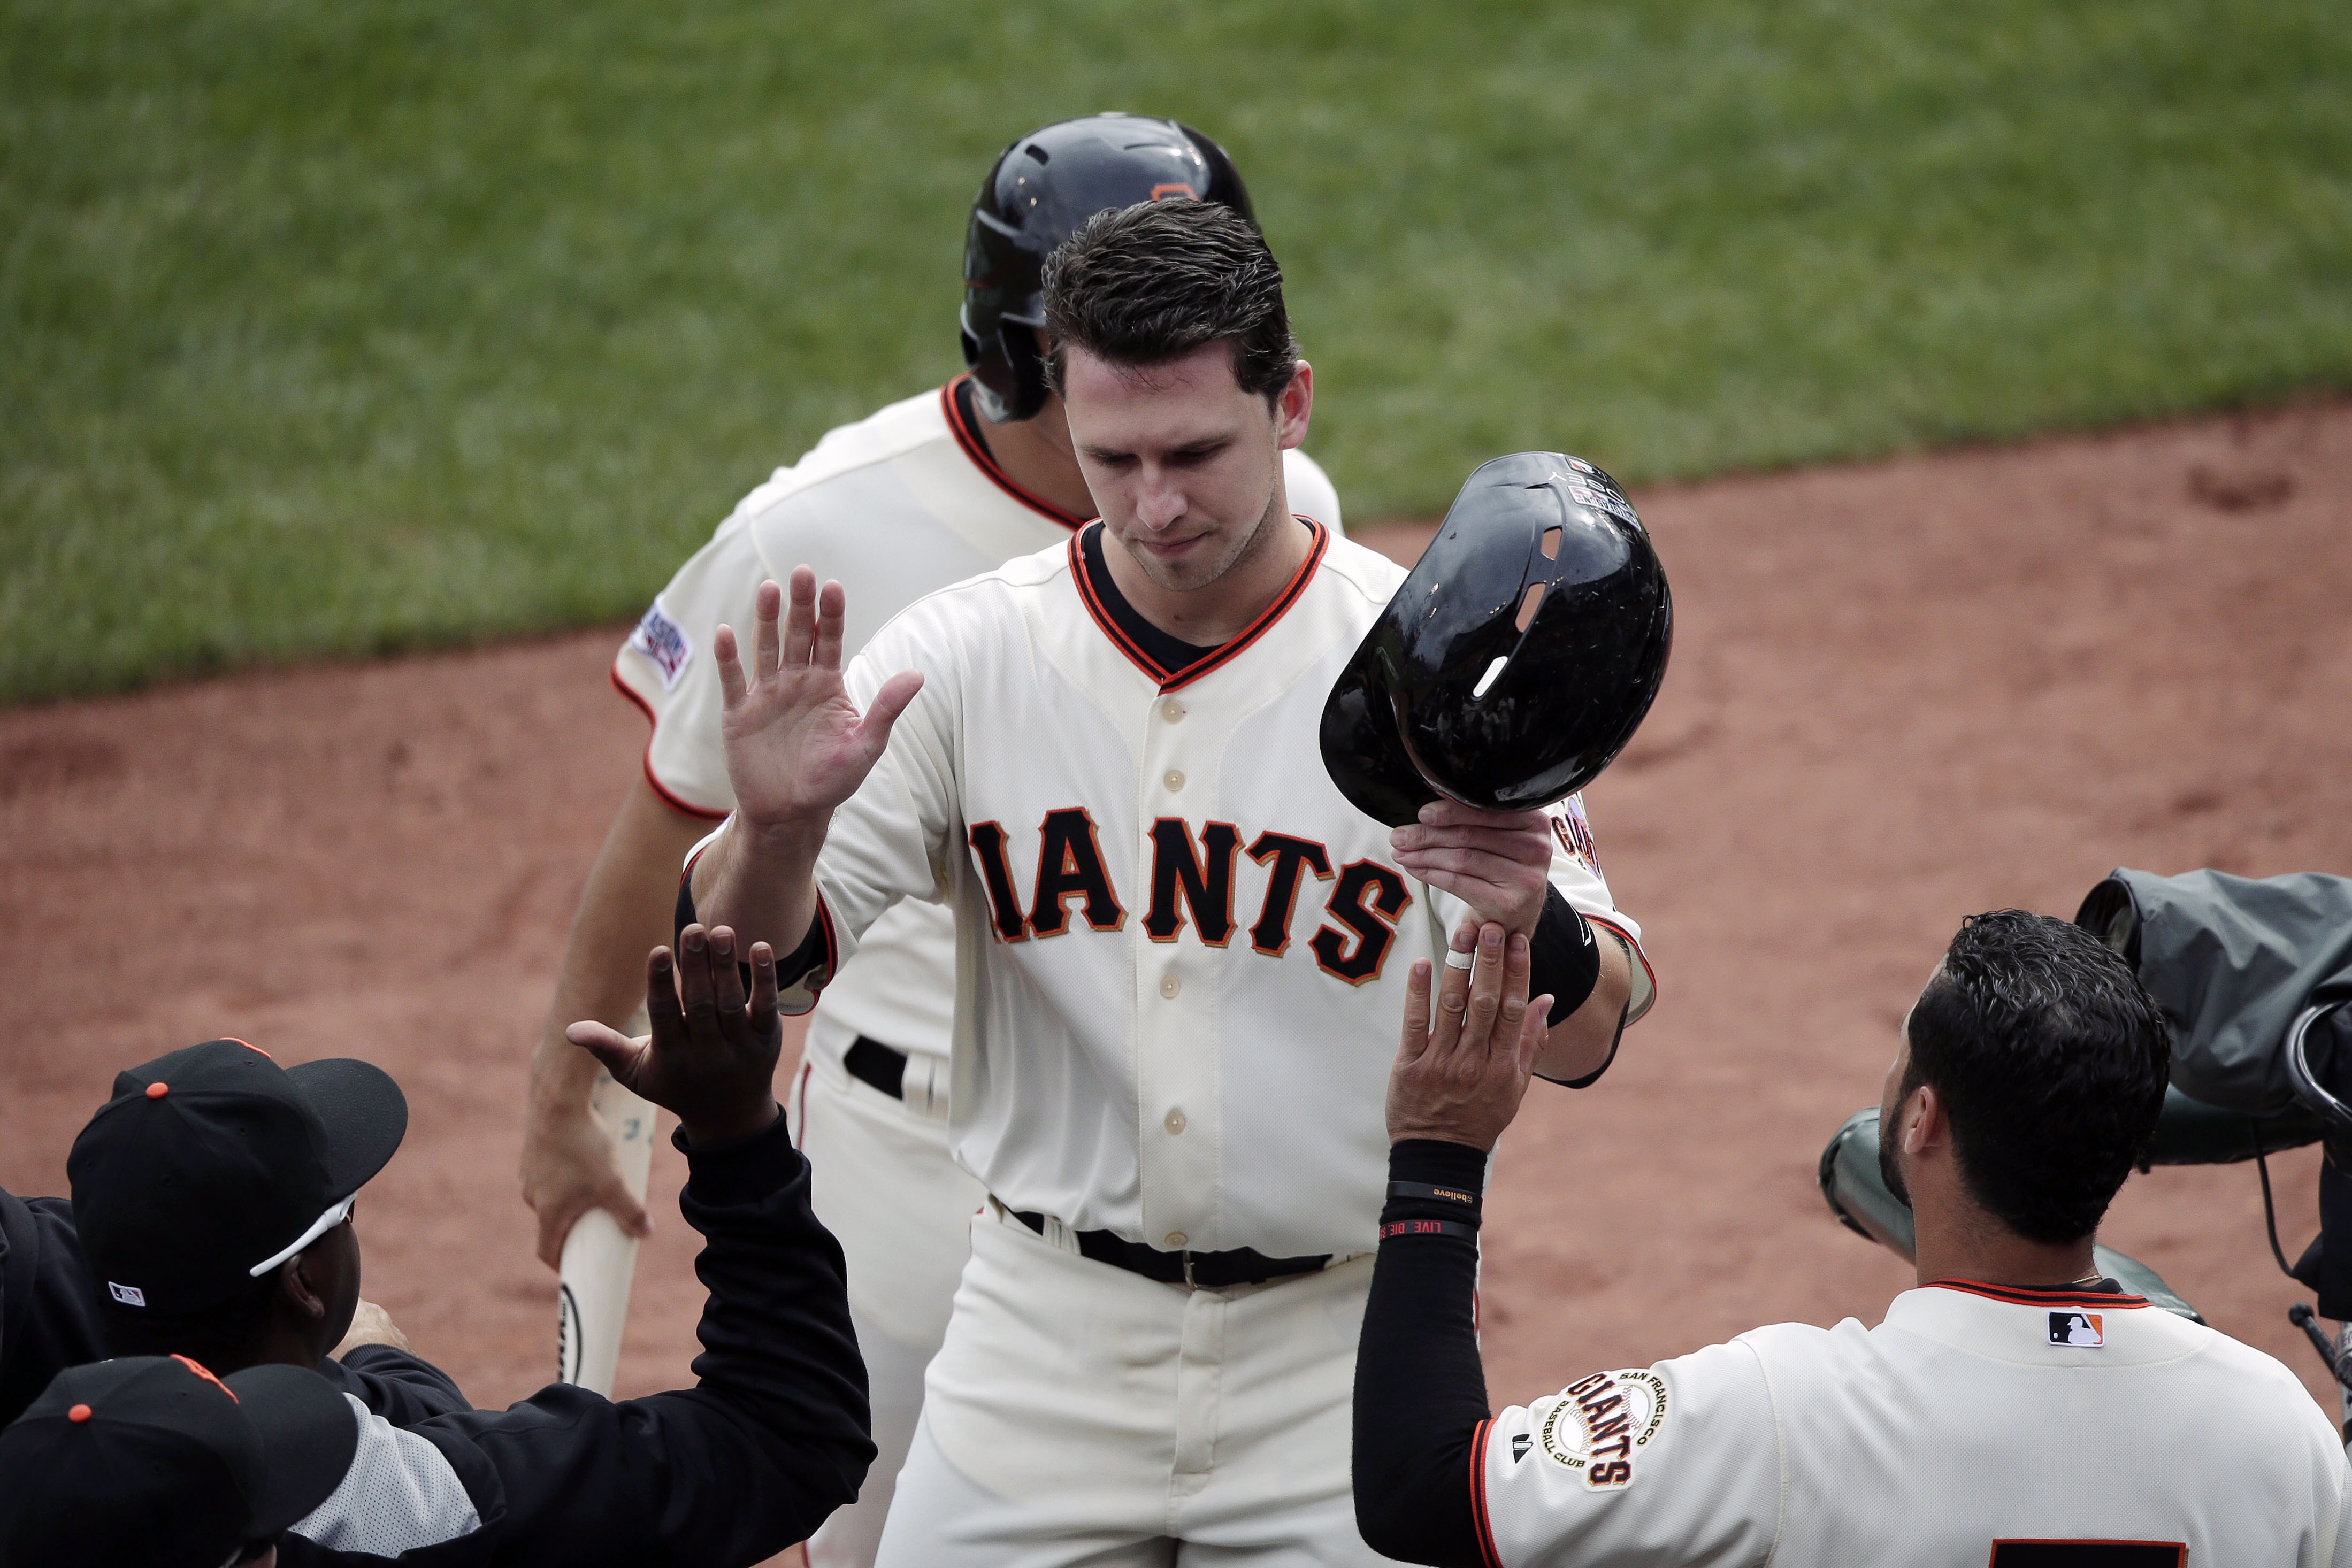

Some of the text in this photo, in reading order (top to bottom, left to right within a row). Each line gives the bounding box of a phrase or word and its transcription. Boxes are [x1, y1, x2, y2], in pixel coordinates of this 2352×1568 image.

[970, 806, 1413, 987] IANTS
[1434, 1188, 1467, 1202] believe
[1542, 1400, 1585, 1467] BASEBALL CLUB
[1567, 1373, 1631, 1487] GIANTS
[1619, 1372, 1667, 1447] SAN FRANCISCO
